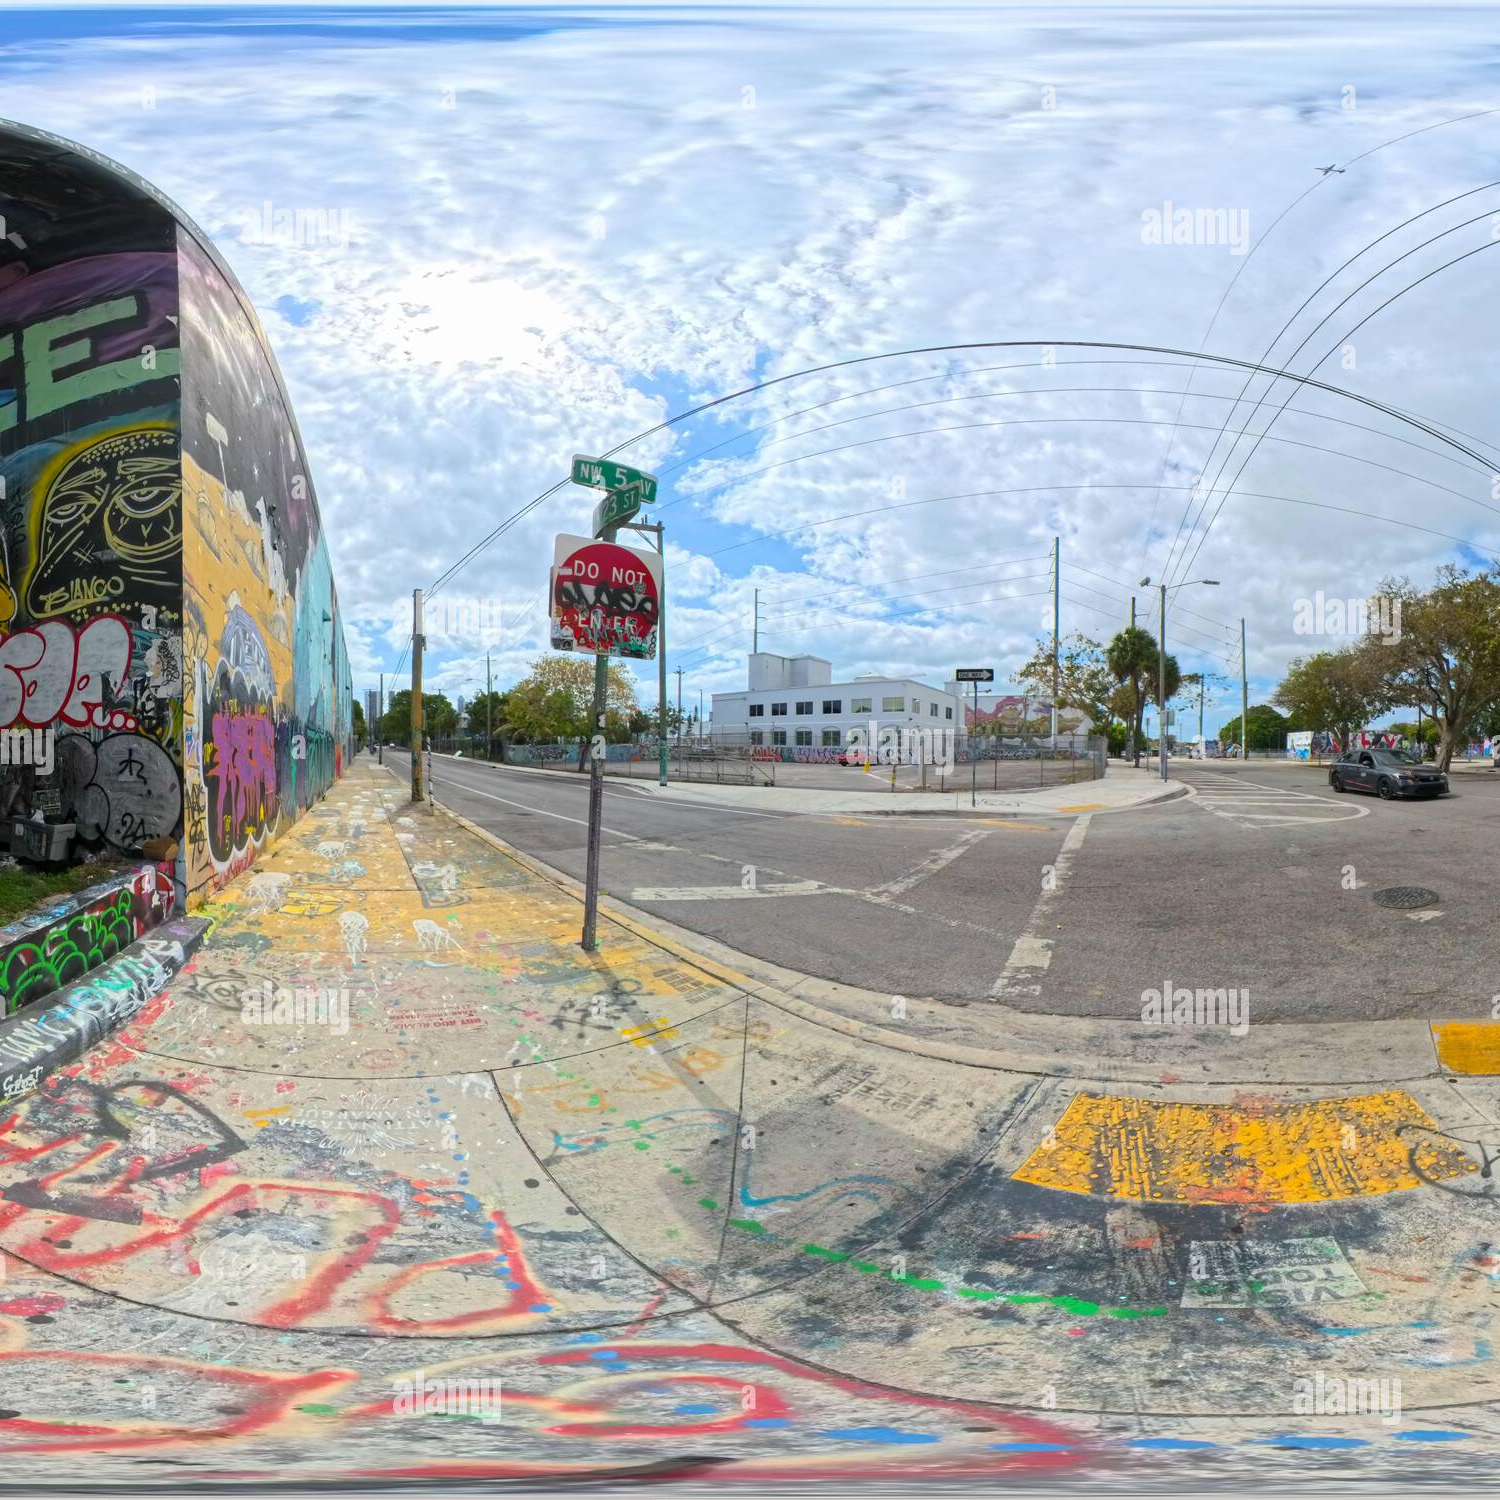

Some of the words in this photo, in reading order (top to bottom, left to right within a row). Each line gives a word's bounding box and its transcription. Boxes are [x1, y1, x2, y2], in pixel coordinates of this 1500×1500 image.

[579, 463, 602, 480] NW
[614, 467, 627, 488] 5
[622, 491, 636, 508] ST
[573, 560, 599, 579] DO
[611, 566, 647, 586] NOT
